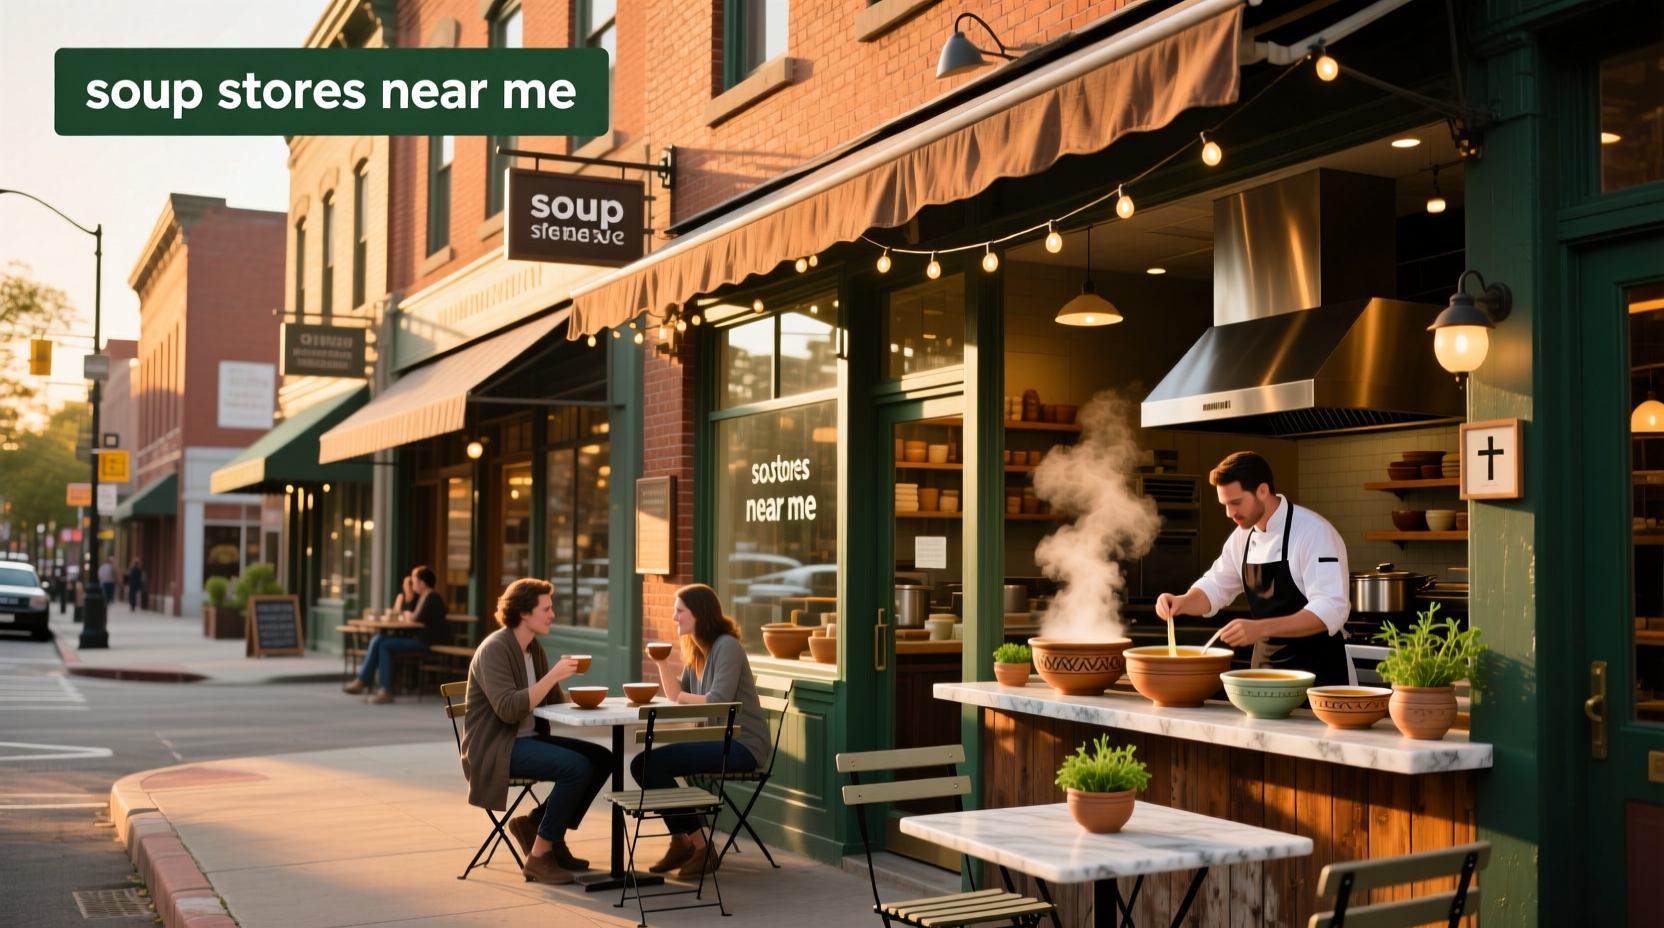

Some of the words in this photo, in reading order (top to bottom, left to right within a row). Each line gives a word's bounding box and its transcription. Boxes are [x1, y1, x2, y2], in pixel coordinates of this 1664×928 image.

[530, 194, 624, 230] soup
[746, 497, 785, 522] near
[787, 494, 817, 521] me
